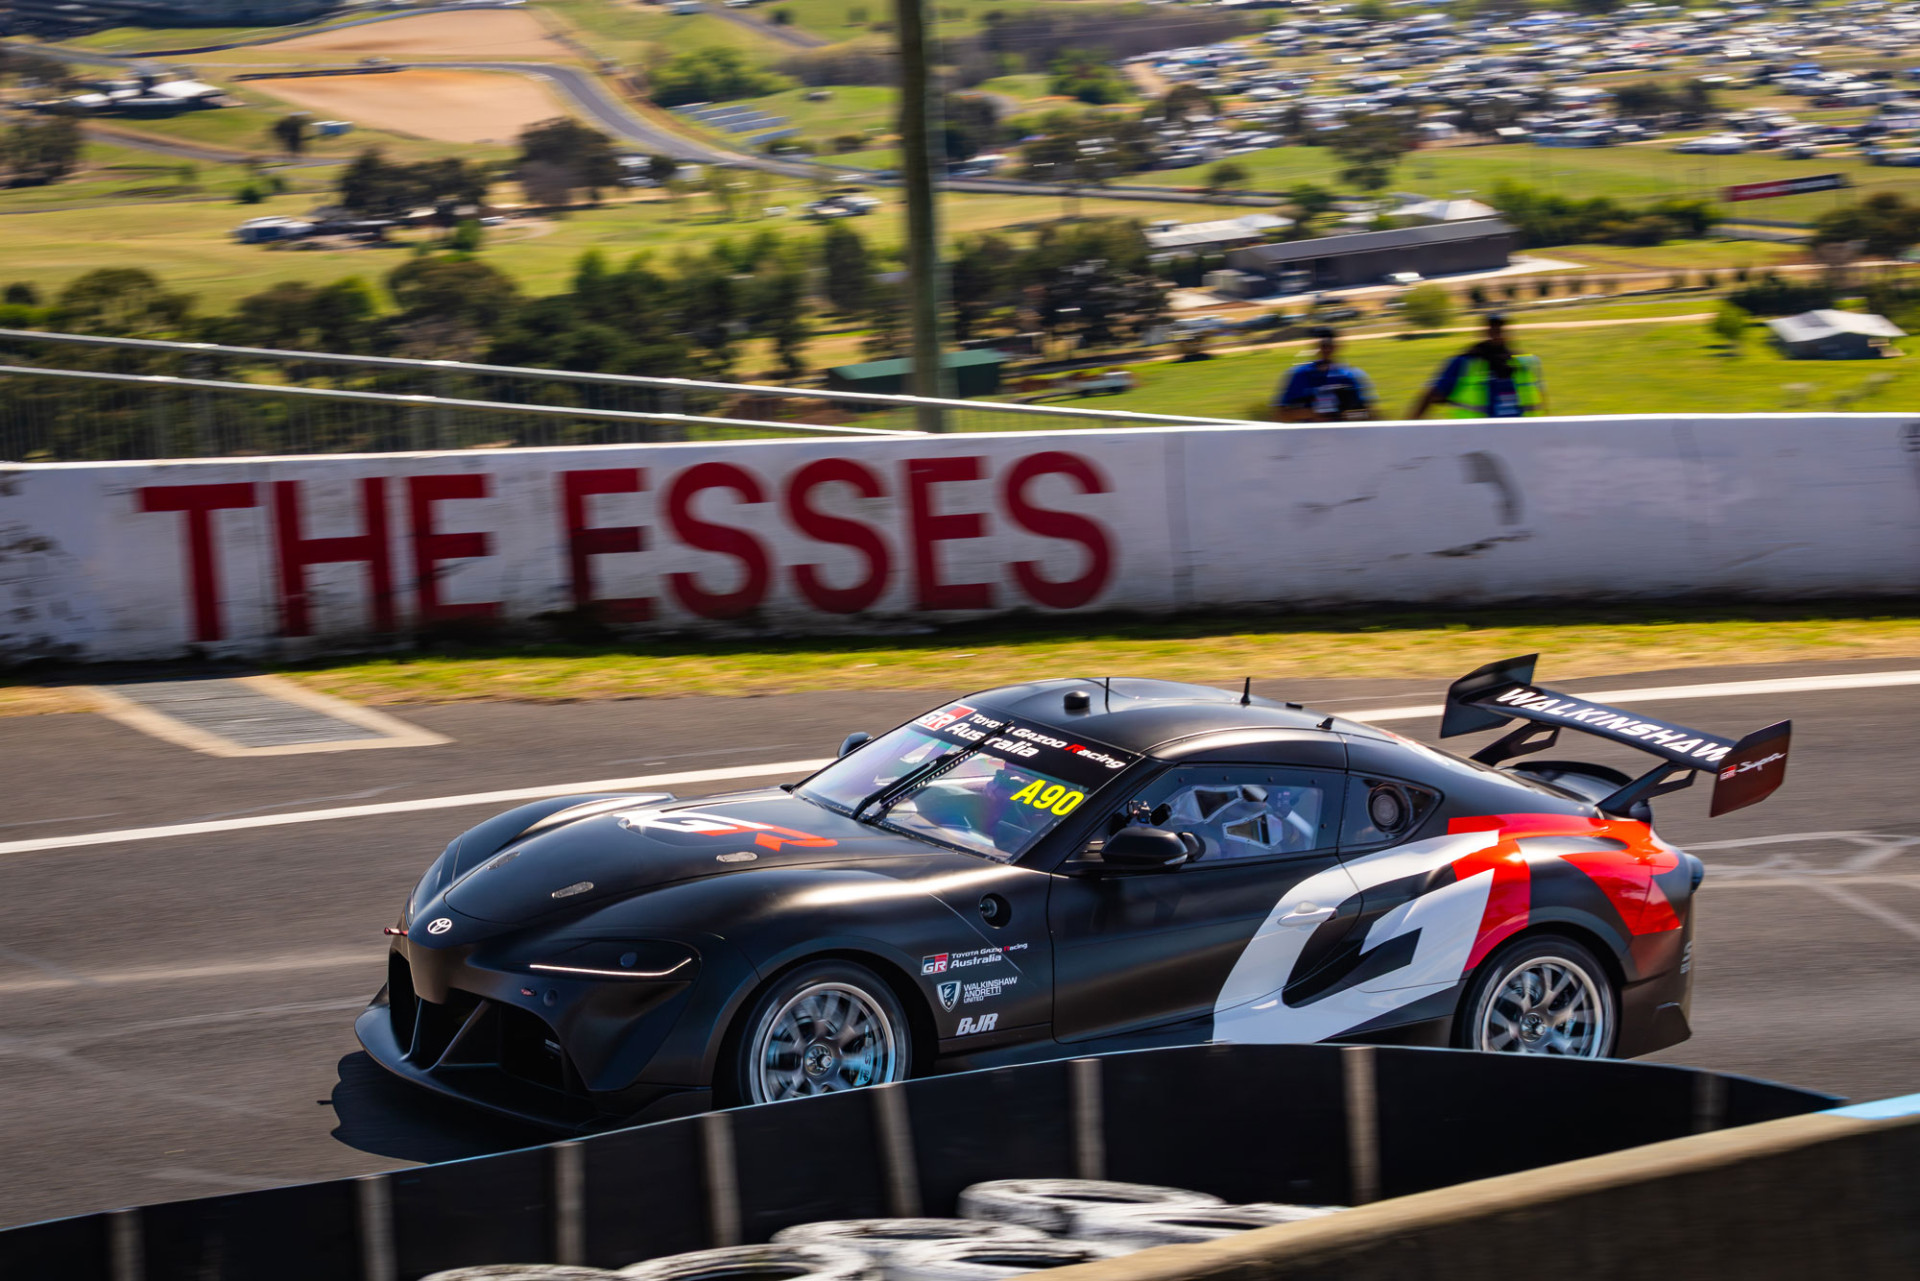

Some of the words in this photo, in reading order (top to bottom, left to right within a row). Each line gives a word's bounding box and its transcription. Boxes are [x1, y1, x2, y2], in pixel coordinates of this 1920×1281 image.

[136, 473, 502, 642] THE
[557, 450, 1118, 620] ESSES
[1496, 688, 1733, 762] WALKINSHAW
[944, 722, 1039, 757] Ausralia
[1064, 744, 1126, 769] Racing
[1009, 779, 1085, 815] A90
[923, 960, 947, 973] GR
[950, 953, 1002, 968] Australia
[963, 976, 1018, 991] WALKINSHAW
[964, 986, 1002, 998] ANDRETTI
[956, 1012, 998, 1036] BJR
